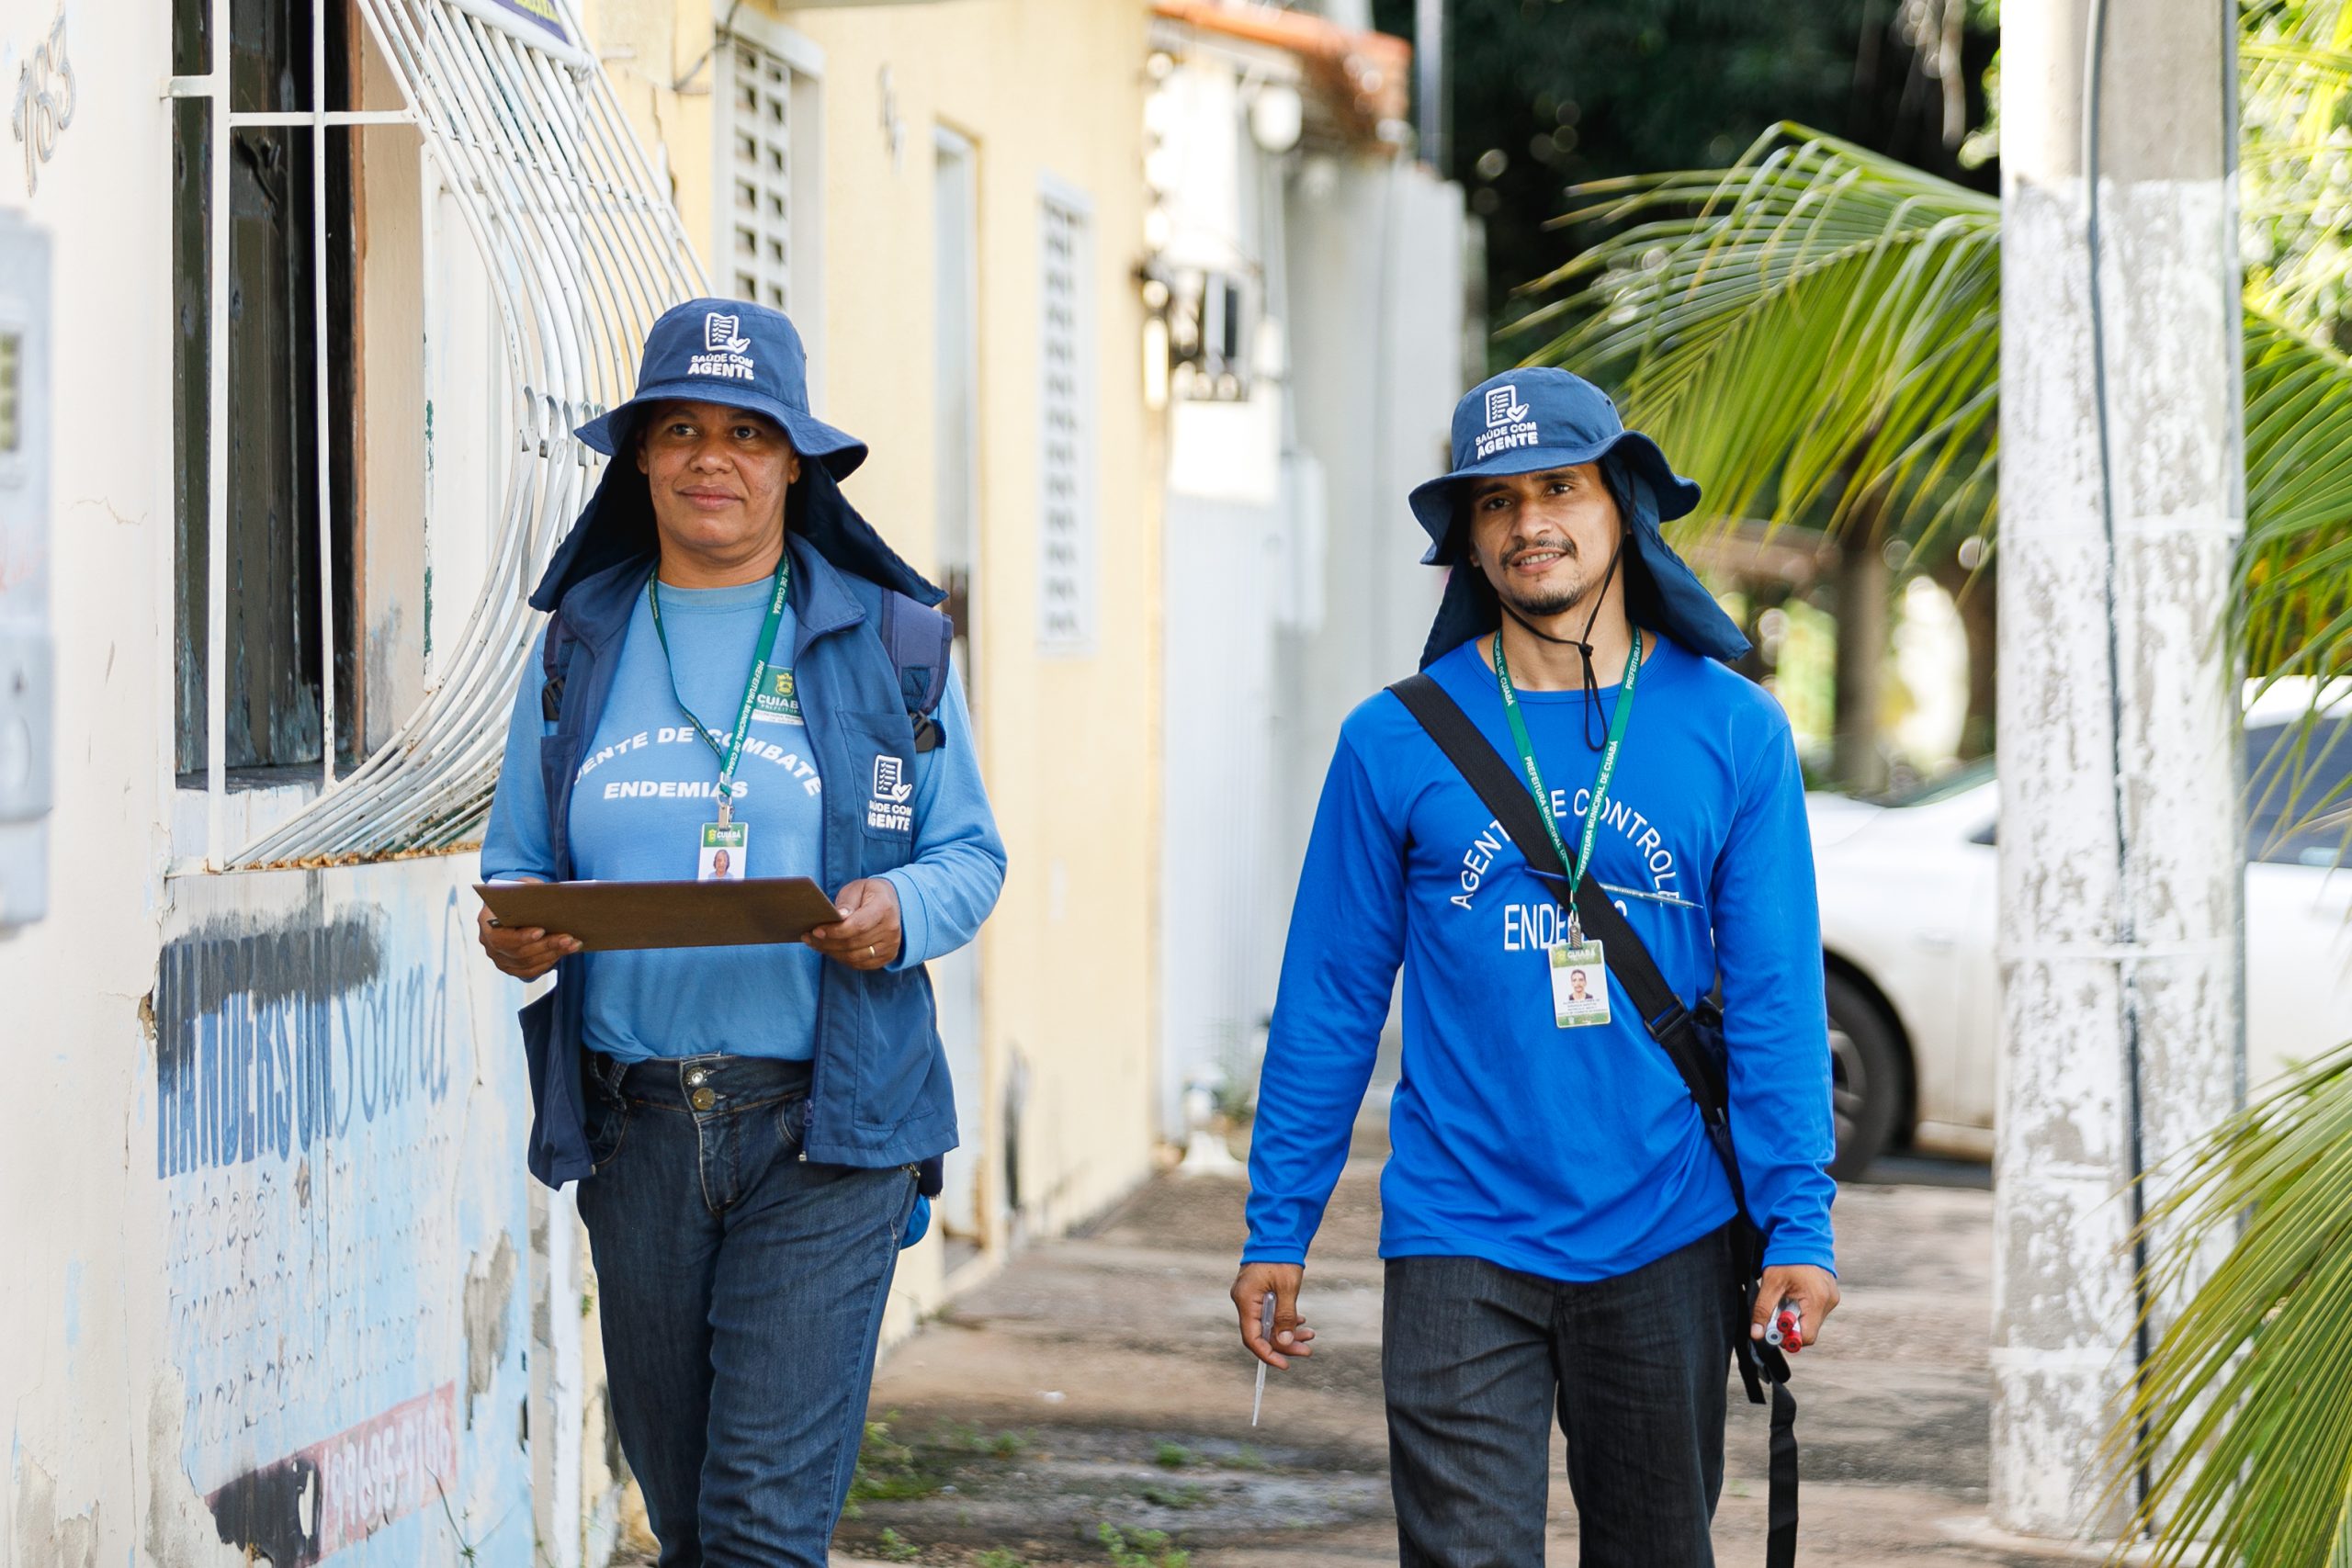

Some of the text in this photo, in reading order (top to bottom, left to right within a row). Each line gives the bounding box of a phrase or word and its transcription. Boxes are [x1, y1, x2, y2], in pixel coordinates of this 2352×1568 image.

[688, 363, 754, 380] AGENTE
[691, 353, 753, 367] SAÚDE COM
[1475, 422, 1537, 446] SAÚDE COM
[1476, 431, 1538, 460] AGENTE
[745, 660, 764, 704] PREFEITURA
[1625, 646, 1641, 690] PREFEITURA
[756, 694, 799, 709] CUIAB
[1499, 676, 1515, 706] CUIABÁ
[657, 727, 695, 744] DE
[1524, 755, 1547, 807] PREFEITURA
[1543, 806, 1562, 850] MUNICIPAL
[1577, 739, 1619, 881] PREFEITURA MUNICIPAL DE CUIABÁ
[1450, 819, 1511, 910] AGENT
